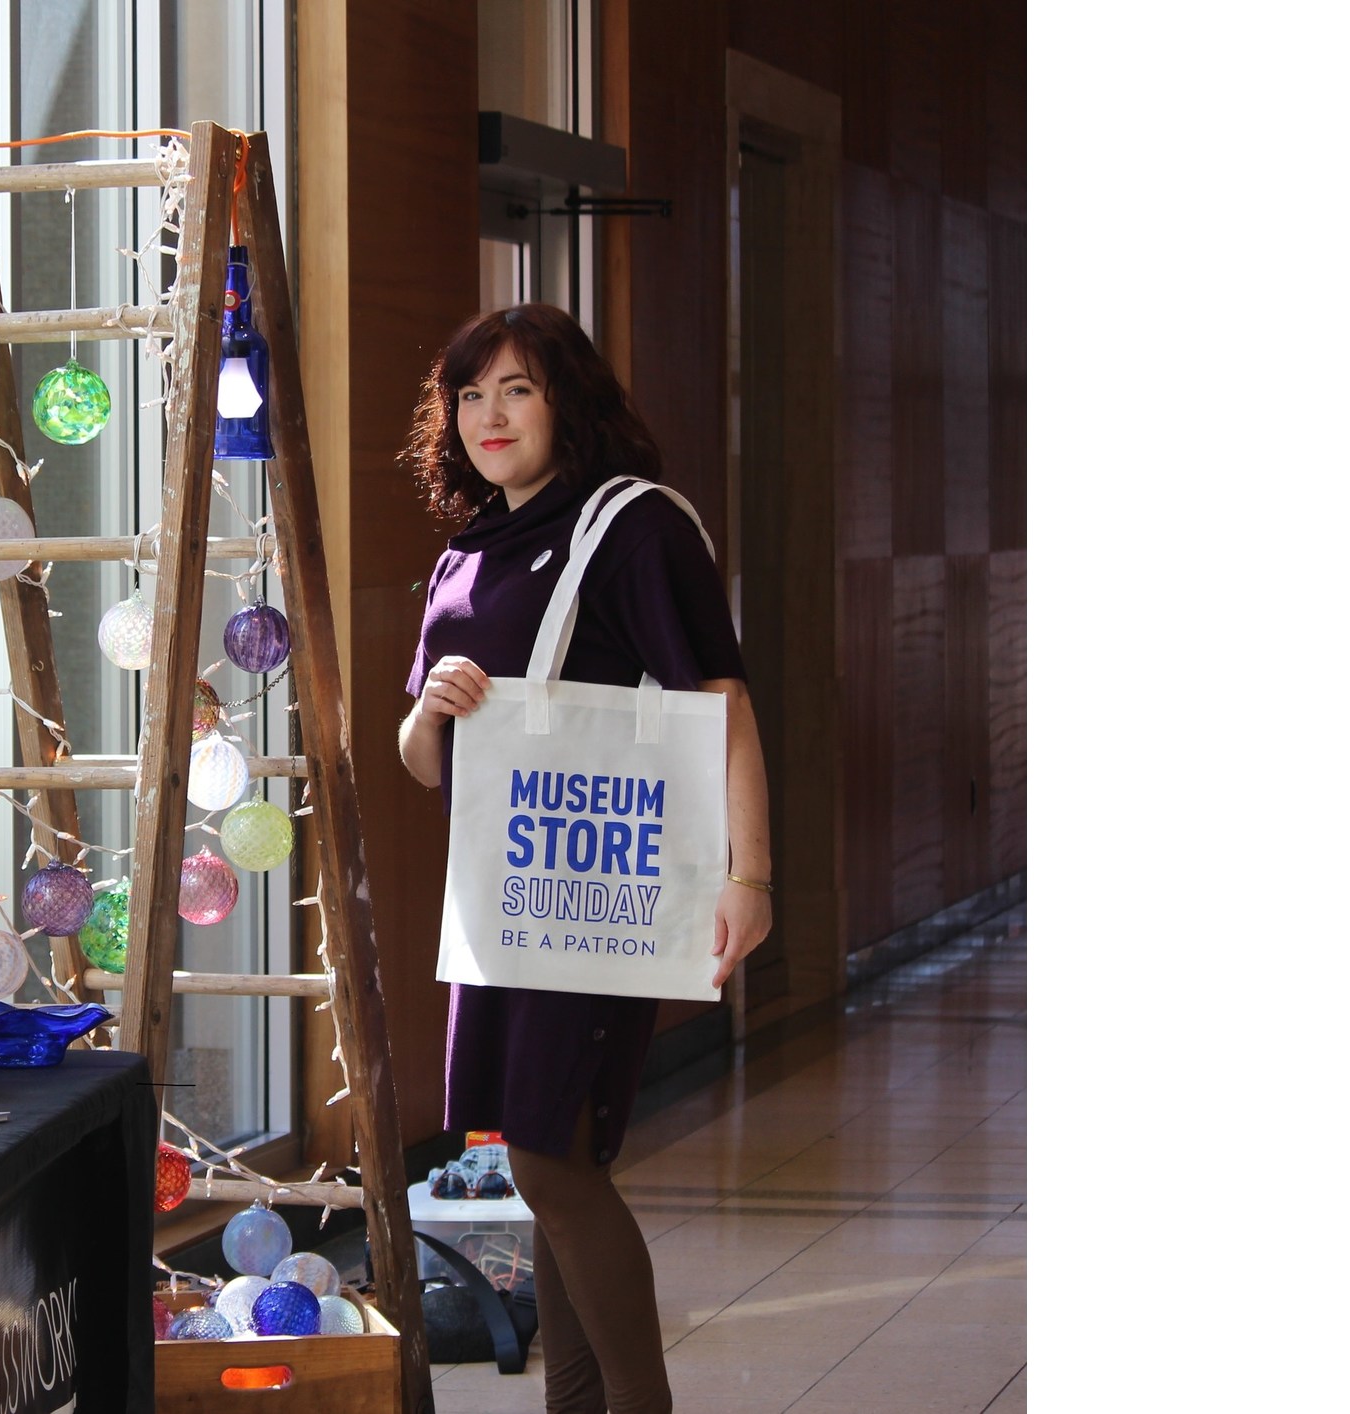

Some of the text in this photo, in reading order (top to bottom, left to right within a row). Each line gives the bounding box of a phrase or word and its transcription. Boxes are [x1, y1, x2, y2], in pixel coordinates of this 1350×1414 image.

[509, 769, 665, 818] MUSEUM
[506, 815, 663, 877] STORE
[502, 875, 662, 926] SUNDAY
[500, 929, 656, 957] BE A PATRON
